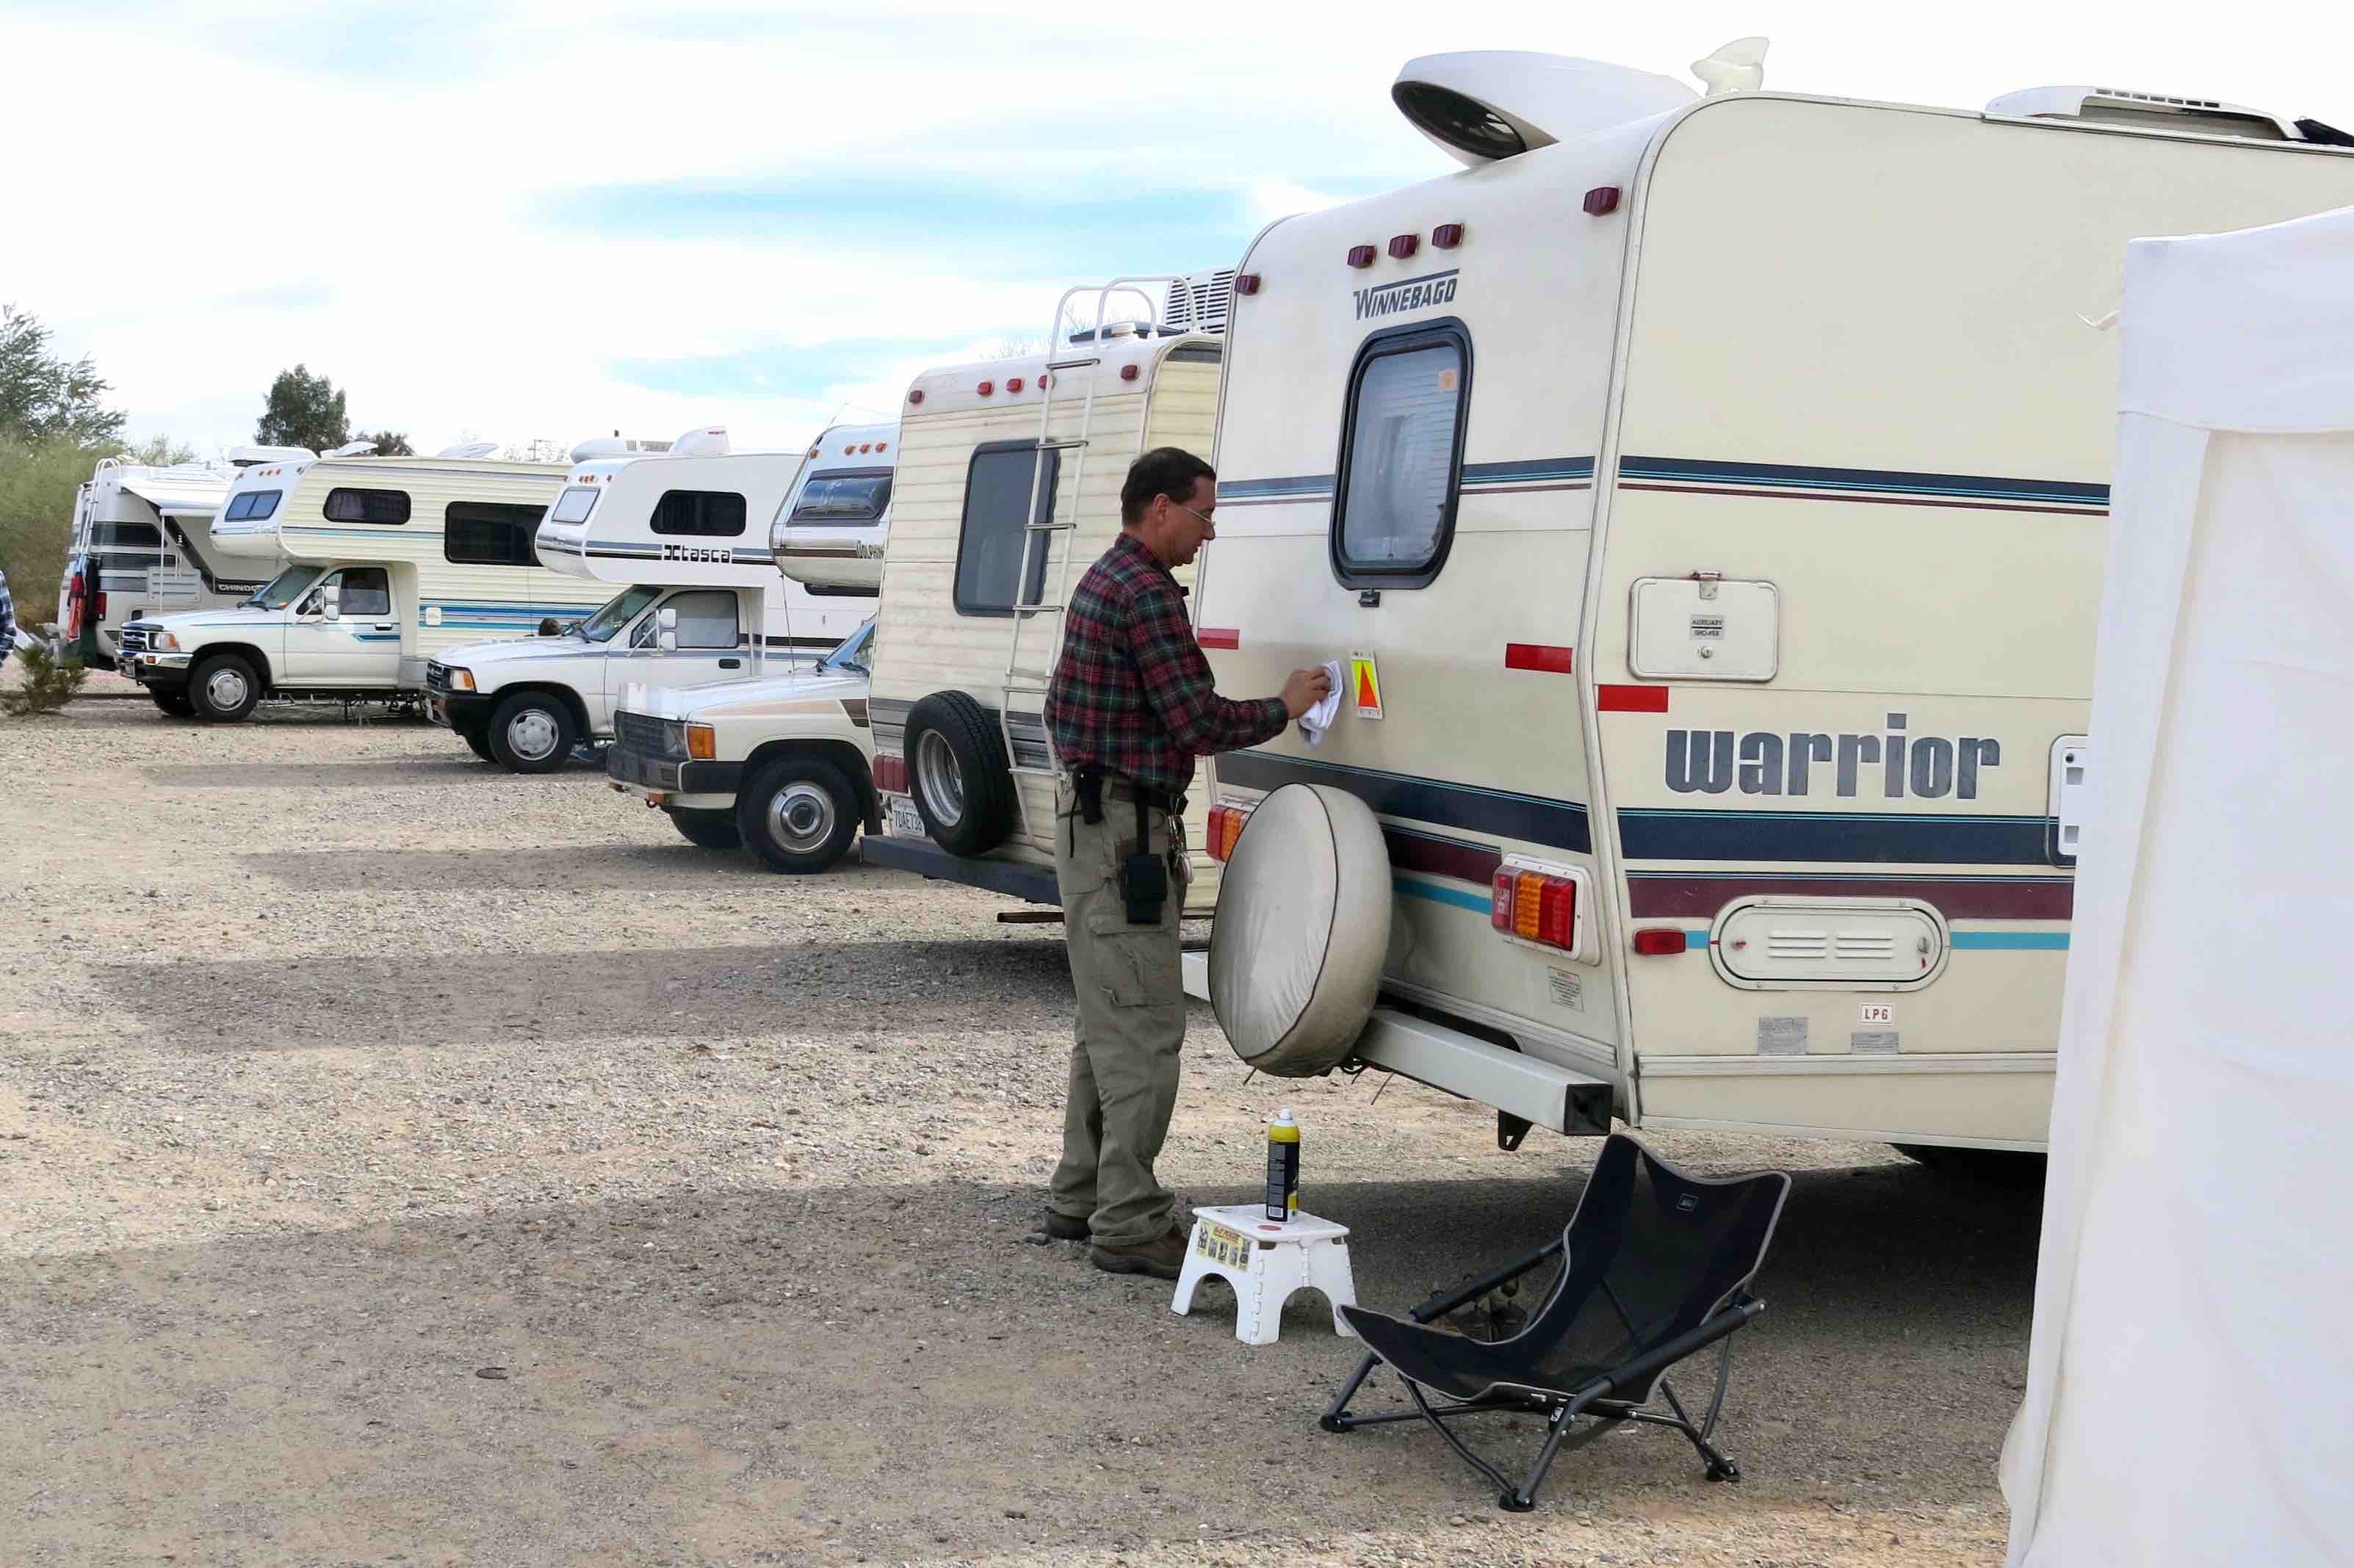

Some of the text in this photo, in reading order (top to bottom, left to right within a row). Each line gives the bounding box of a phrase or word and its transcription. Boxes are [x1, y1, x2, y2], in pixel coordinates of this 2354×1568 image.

[1352, 270, 1459, 321] WINNEBAGO
[1665, 712, 2000, 800] warrior
[1864, 1008, 1889, 1020] LPG
